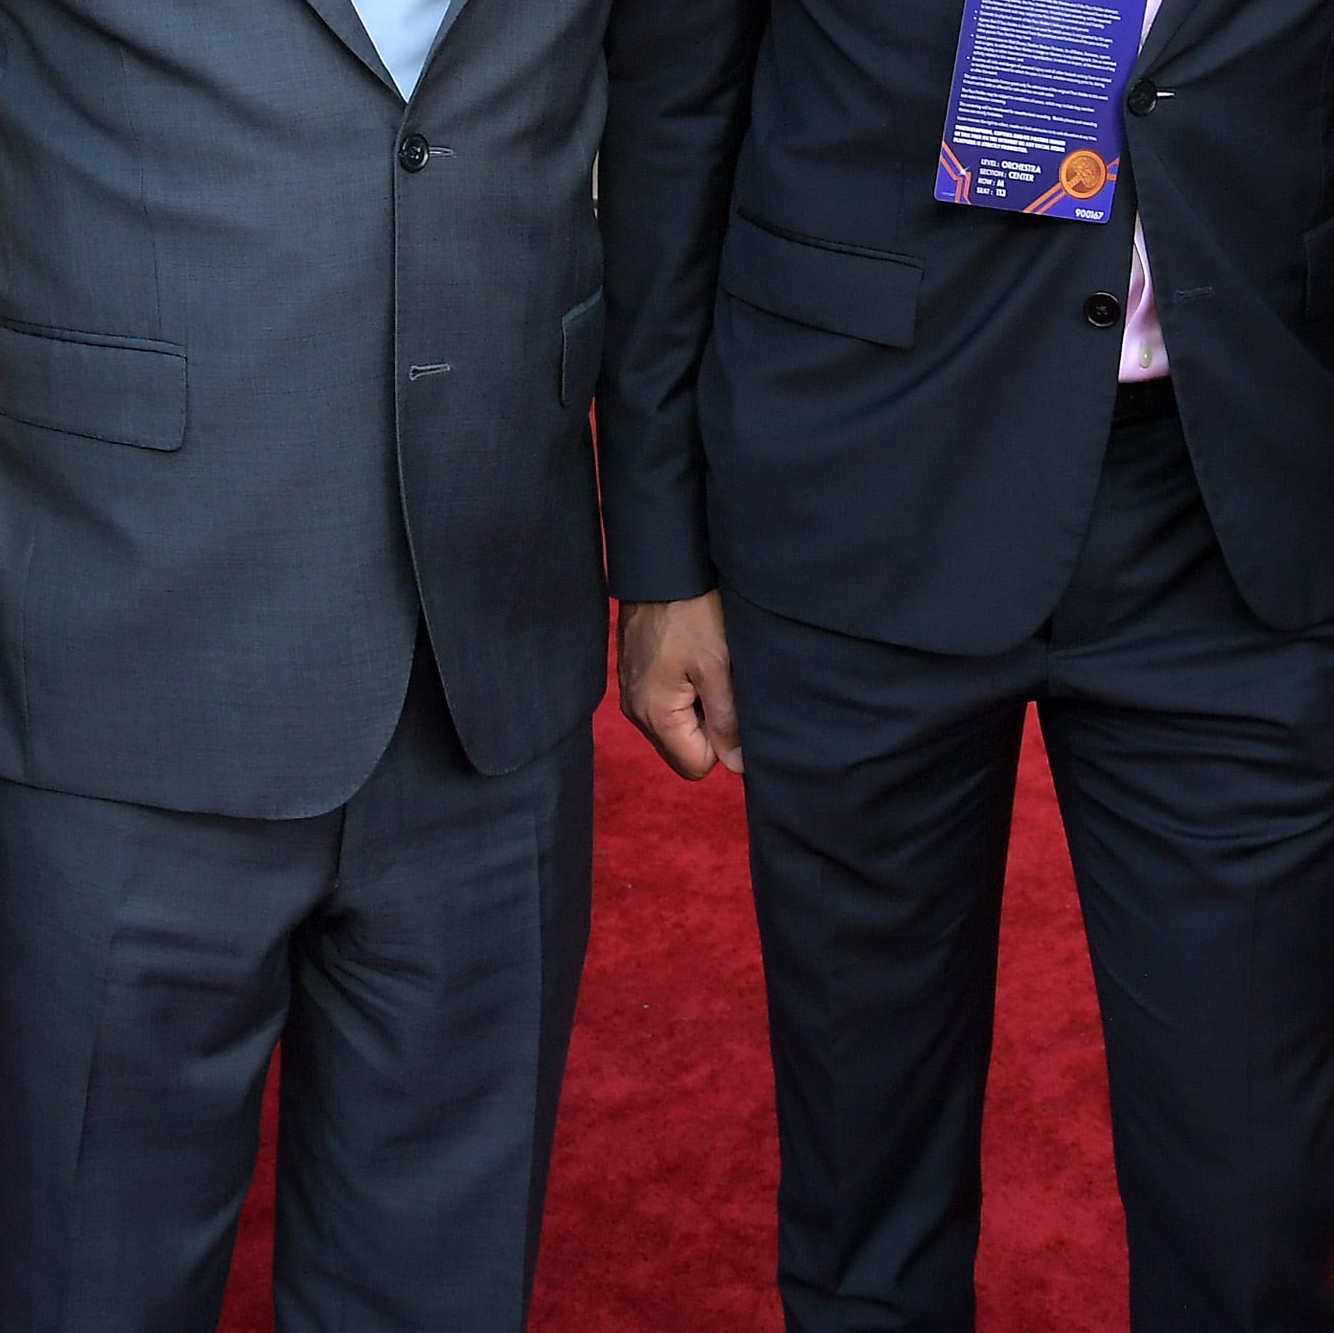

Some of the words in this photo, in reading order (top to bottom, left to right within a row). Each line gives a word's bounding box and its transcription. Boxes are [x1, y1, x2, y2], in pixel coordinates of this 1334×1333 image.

[1001, 160, 1042, 174] ORCHESTRA
[1008, 171, 1035, 182] CENTER
[1075, 208, 1105, 220] 900167
